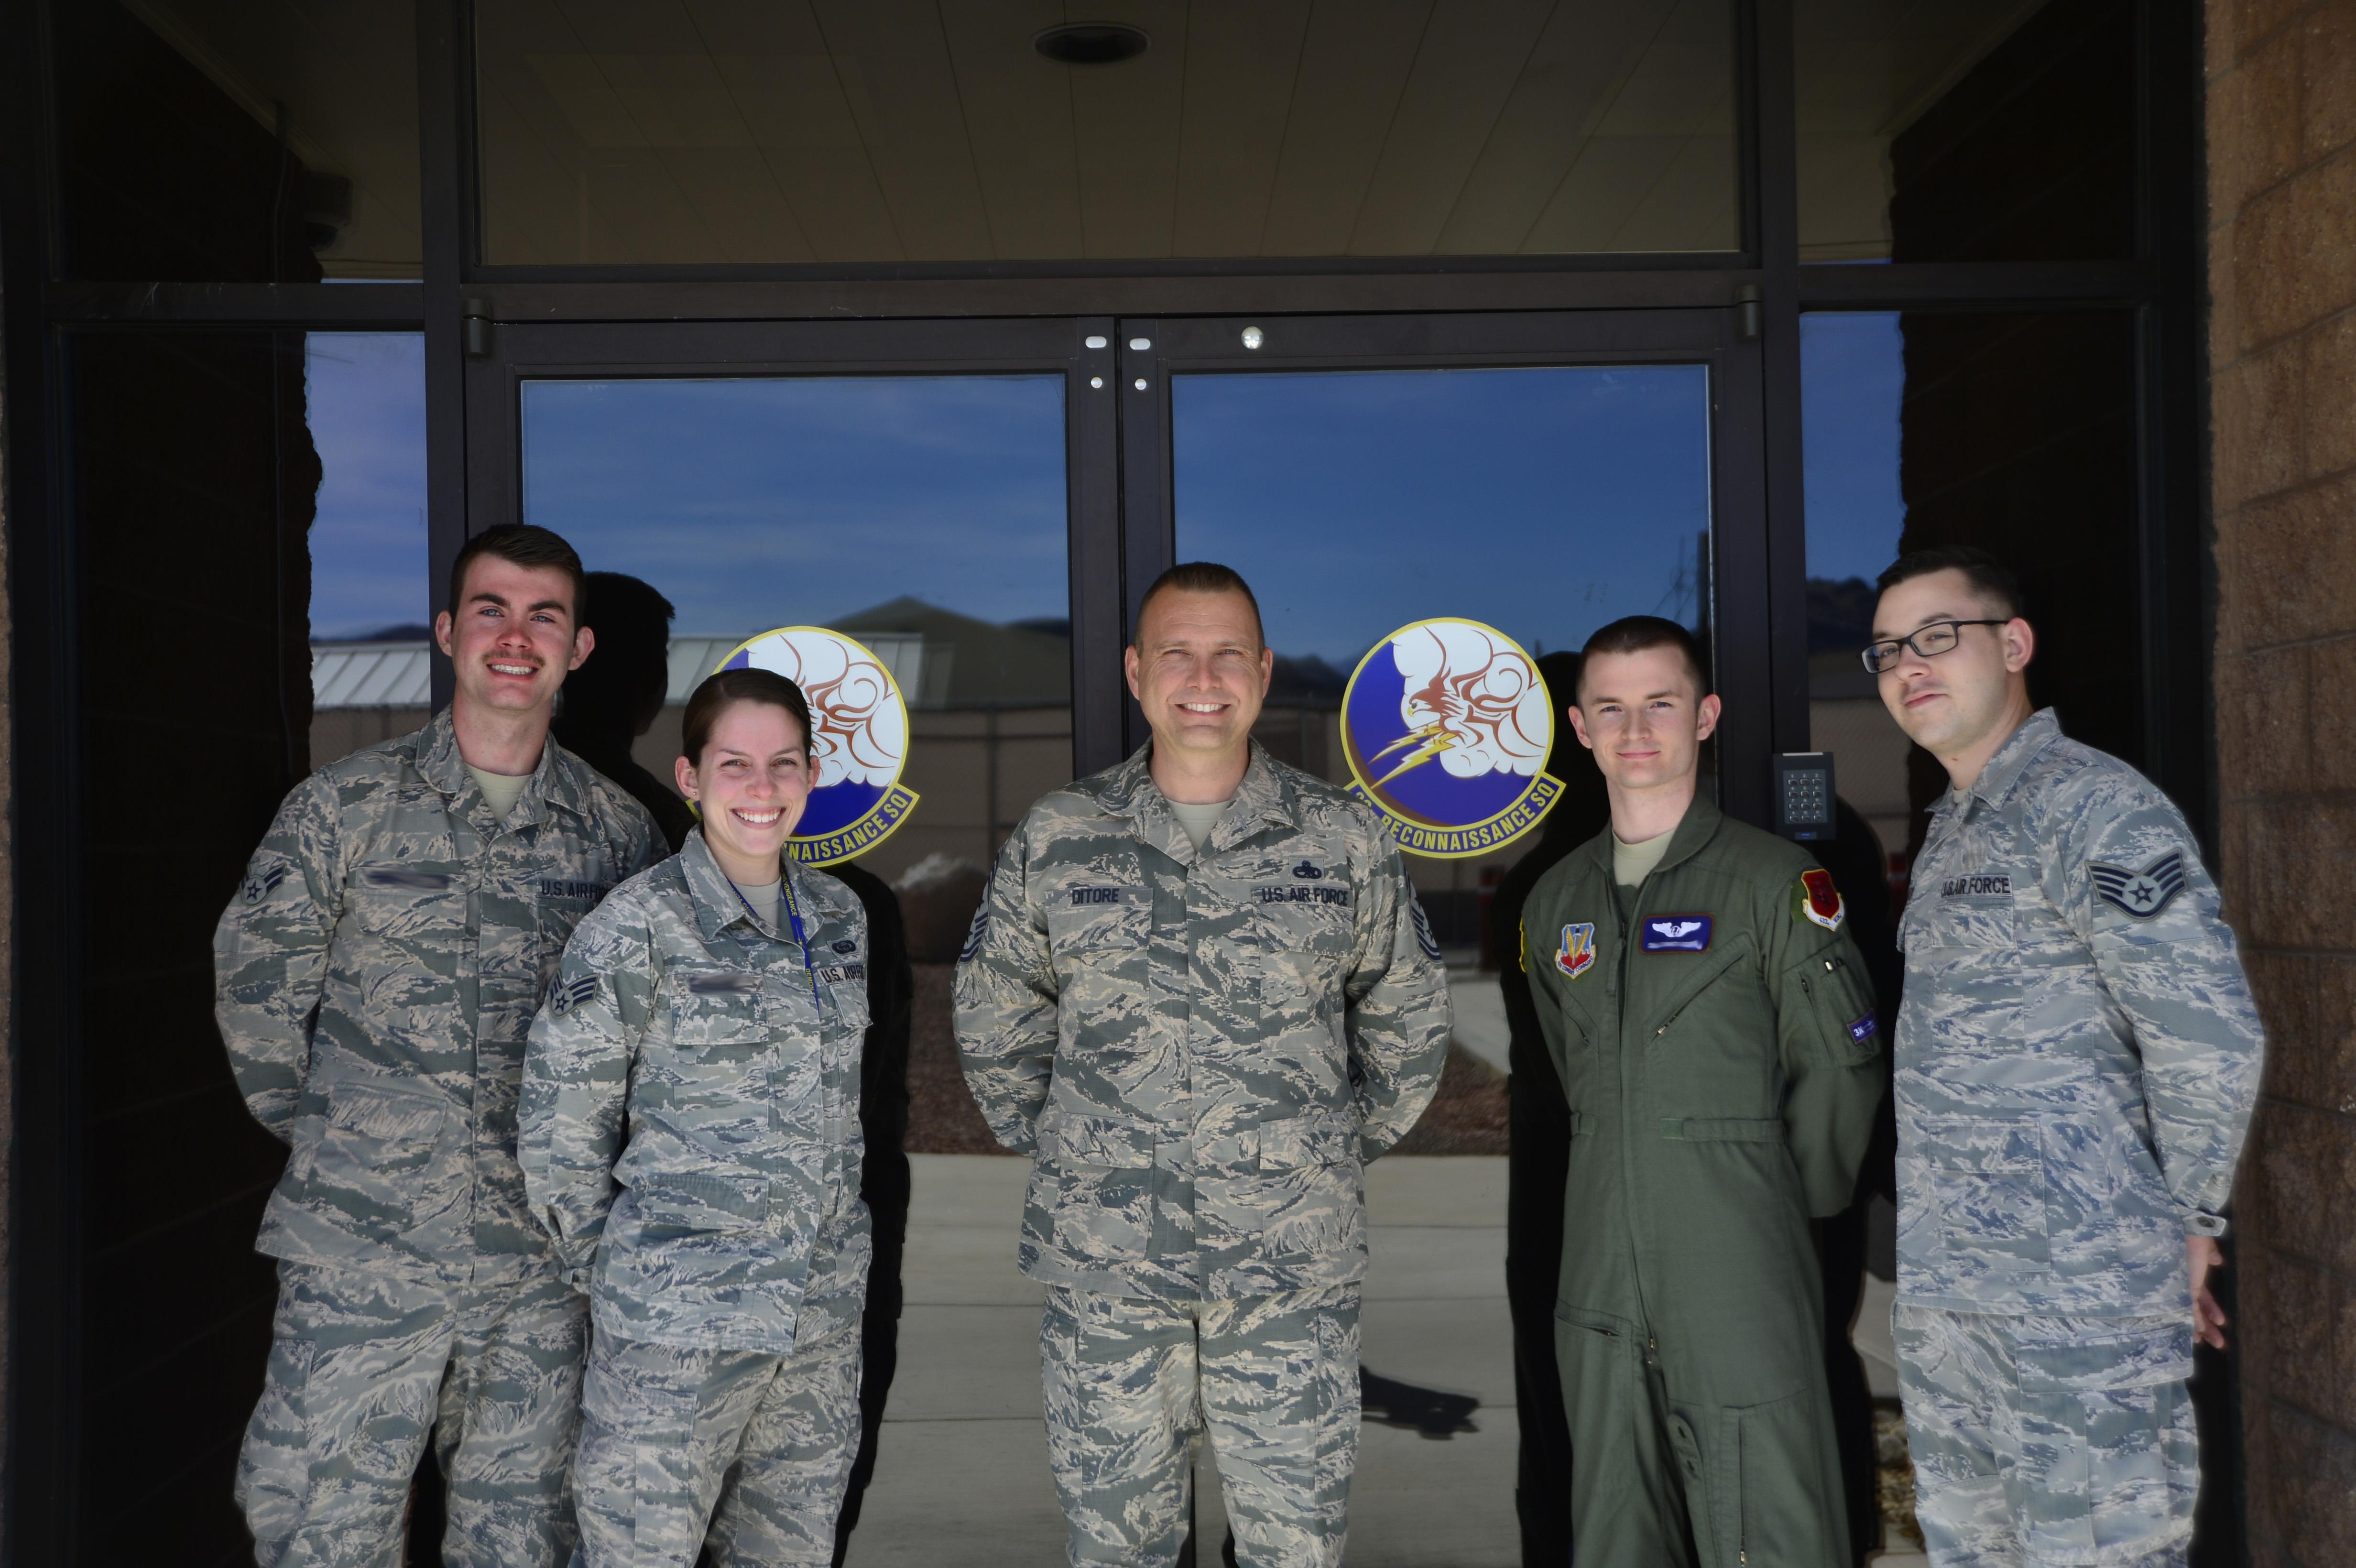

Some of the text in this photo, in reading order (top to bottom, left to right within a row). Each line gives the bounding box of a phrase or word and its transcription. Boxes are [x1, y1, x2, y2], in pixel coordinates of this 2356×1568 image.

[1381, 783, 1555, 850] RECONNAISSANCE SQ
[784, 794, 908, 860] NAISSANCE SQ
[542, 880, 564, 896] U.S.
[567, 882, 588, 898] AIR
[1968, 878, 2011, 893] FORCE
[783, 882, 797, 916] VENGEANCE
[1072, 888, 1120, 904] DITORE
[1262, 887, 1348, 907] U.S. AIR FORCE
[806, 969, 814, 991] DEMON
[820, 968, 843, 983] U.S.
[843, 965, 858, 980] AIR
[1854, 1026, 1865, 1036] 3K
